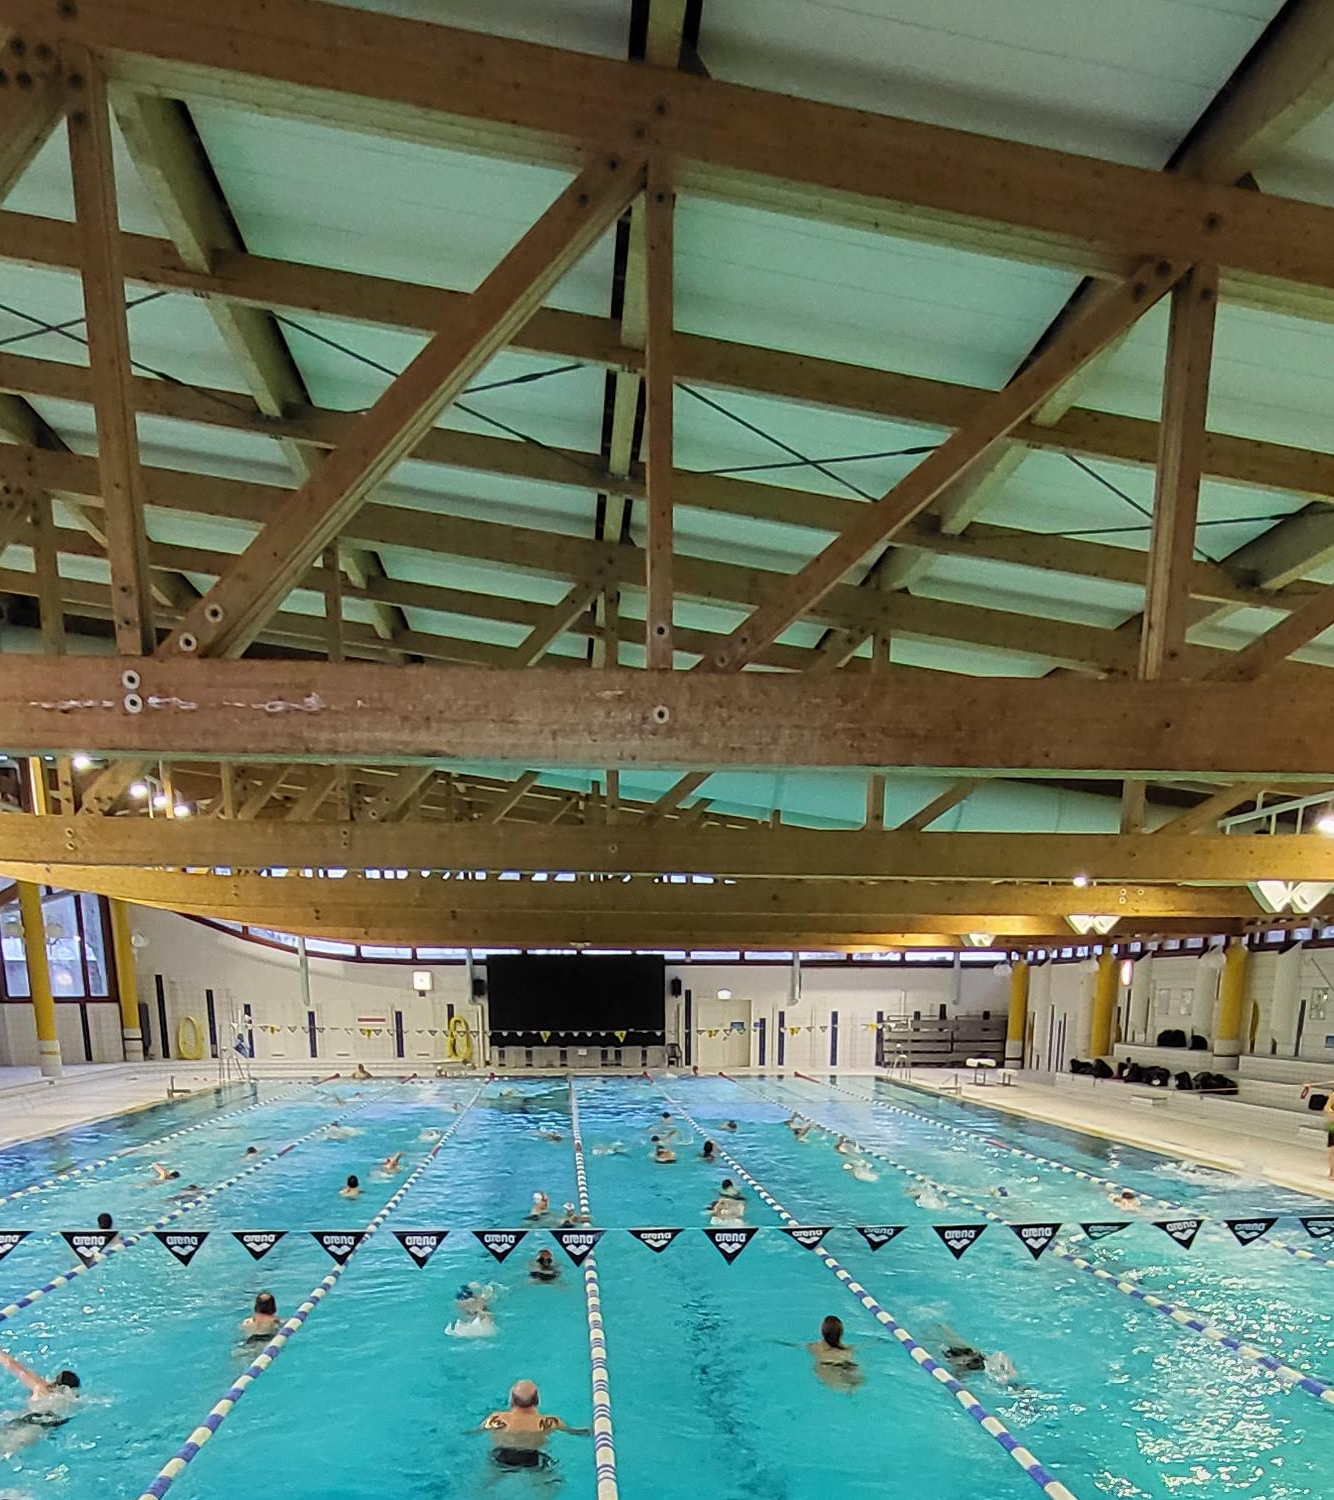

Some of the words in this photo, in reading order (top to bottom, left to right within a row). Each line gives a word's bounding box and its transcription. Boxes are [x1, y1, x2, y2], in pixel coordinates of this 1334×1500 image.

[1166, 1221, 1198, 1231] arena
[640, 1232, 672, 1240] arena
[714, 1232, 747, 1243] arena
[792, 1229, 823, 1237] arena
[944, 1230, 976, 1239] arena
[1021, 1227, 1053, 1238] arena
[72, 1236, 105, 1246] arena
[166, 1236, 198, 1246] arena
[243, 1234, 276, 1243] arena
[323, 1235, 355, 1246] arena
[405, 1235, 438, 1246] arena
[484, 1234, 517, 1244] arena
[562, 1234, 595, 1244] arena
